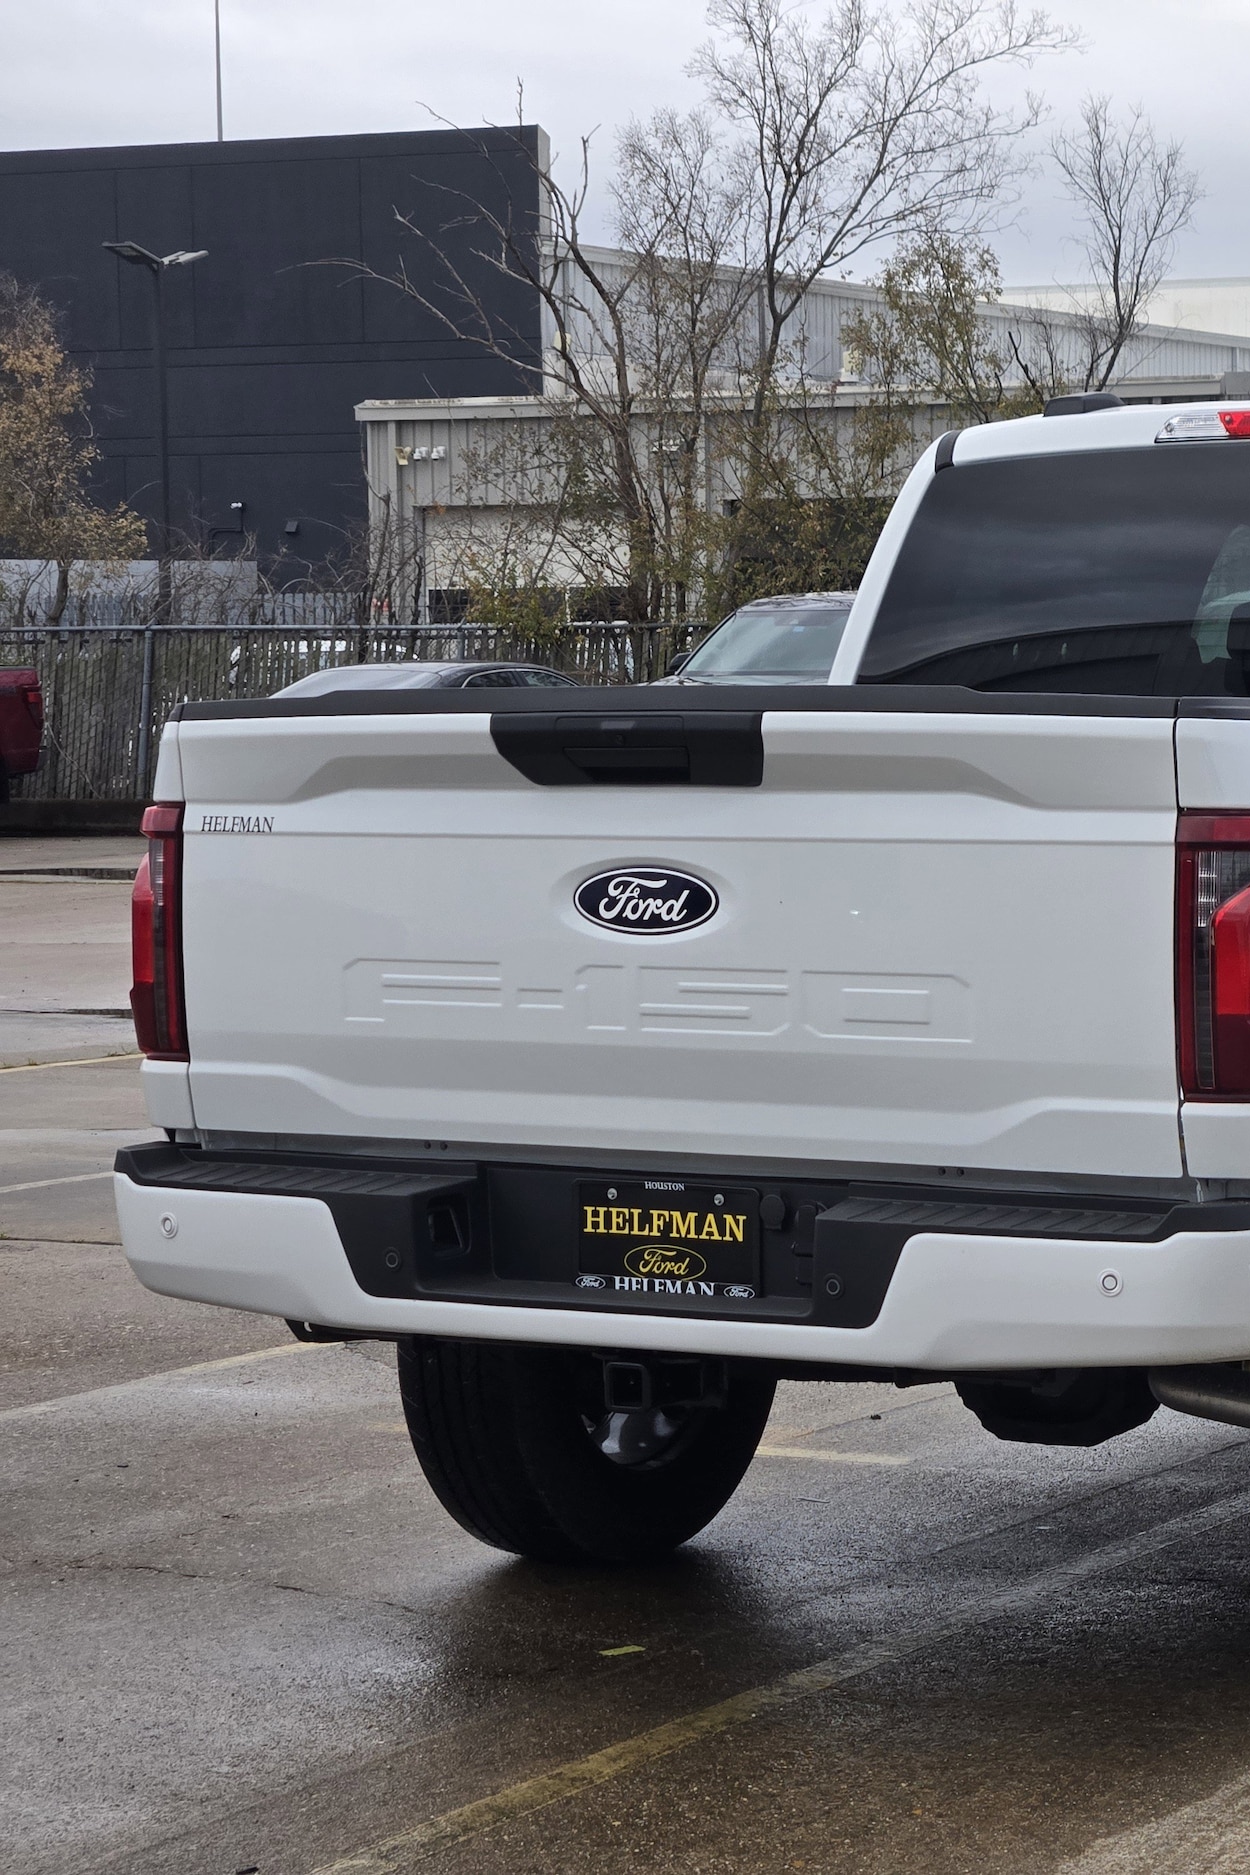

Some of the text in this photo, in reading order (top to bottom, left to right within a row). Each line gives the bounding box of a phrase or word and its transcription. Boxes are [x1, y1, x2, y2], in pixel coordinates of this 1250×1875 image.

[201, 815, 275, 833] HELFMAN
[598, 876, 690, 921] Ford
[342, 957, 973, 1043] F-150
[644, 1181, 685, 1192] HOUSTON
[583, 1206, 747, 1242] HELFMAN
[639, 1248, 690, 1276] Ford
[579, 1276, 601, 1288] Ford
[728, 1286, 750, 1298] Ford
